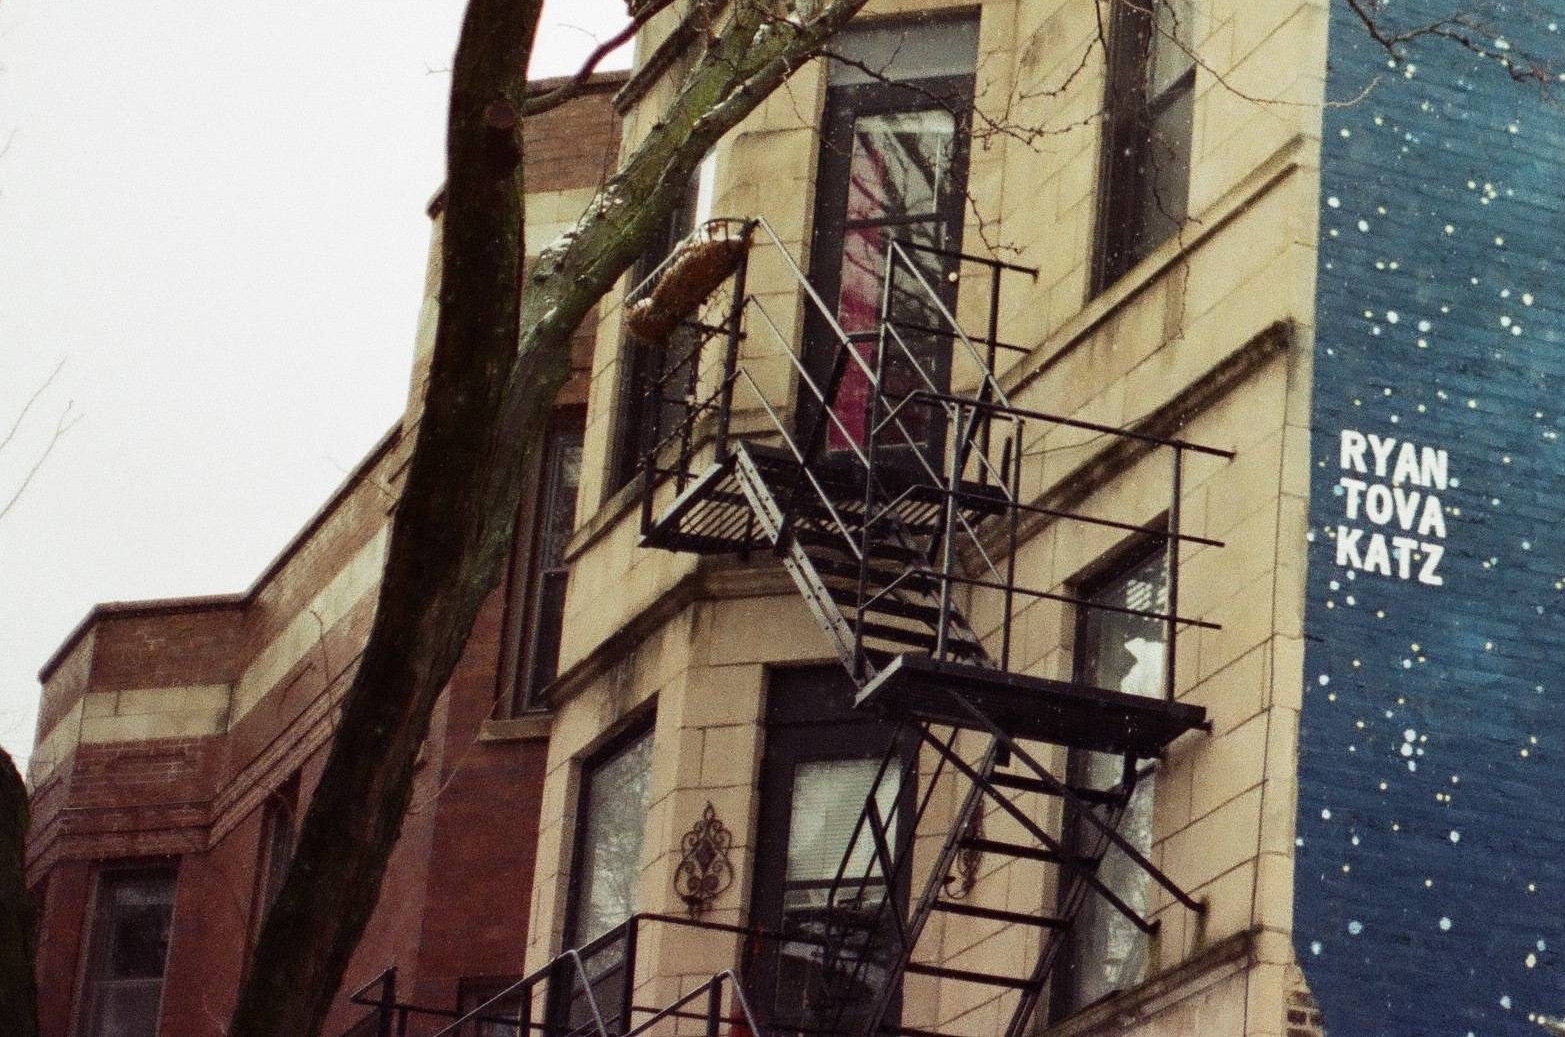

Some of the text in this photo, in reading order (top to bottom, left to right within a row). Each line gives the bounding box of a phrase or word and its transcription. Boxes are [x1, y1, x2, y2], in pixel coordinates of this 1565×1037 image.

[1340, 429, 1449, 491] RYAN
[1339, 476, 1447, 539] TOVA
[1335, 524, 1446, 586] KATZ
